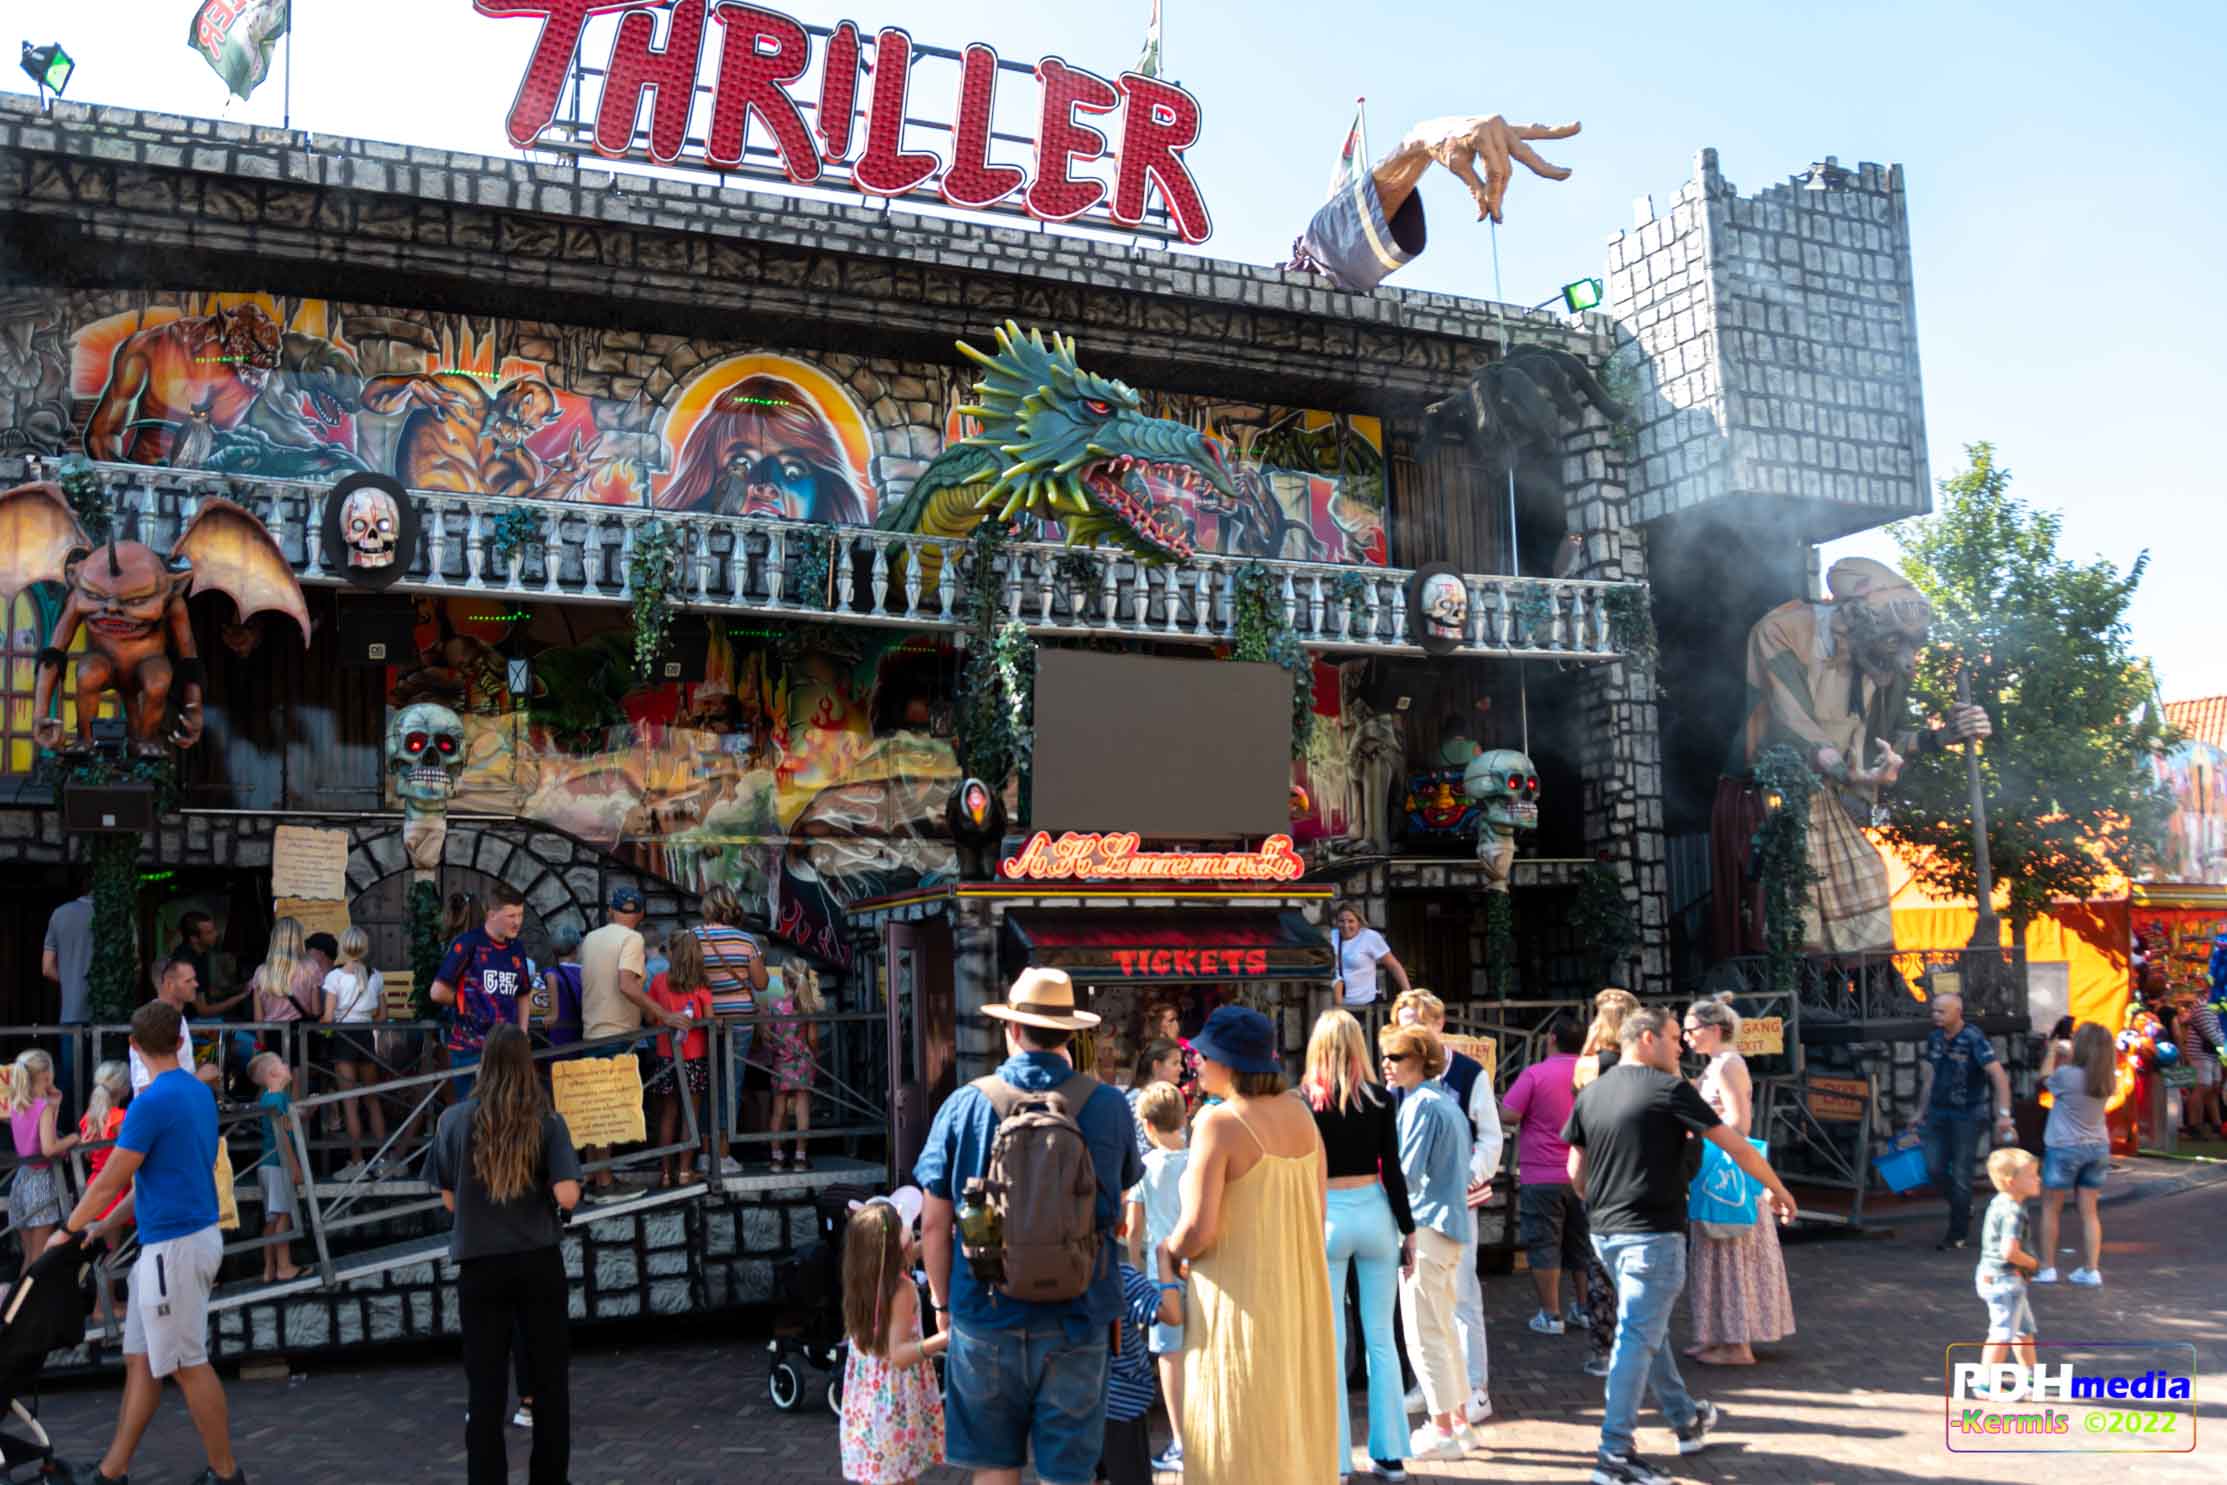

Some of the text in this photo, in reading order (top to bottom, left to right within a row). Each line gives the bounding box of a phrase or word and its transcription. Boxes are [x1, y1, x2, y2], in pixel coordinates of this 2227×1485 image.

[473, 0, 1212, 243] THRILLER
[1111, 948, 1268, 977] TICKETS
[499, 971, 518, 984] BET
[499, 983, 519, 996] CITY
